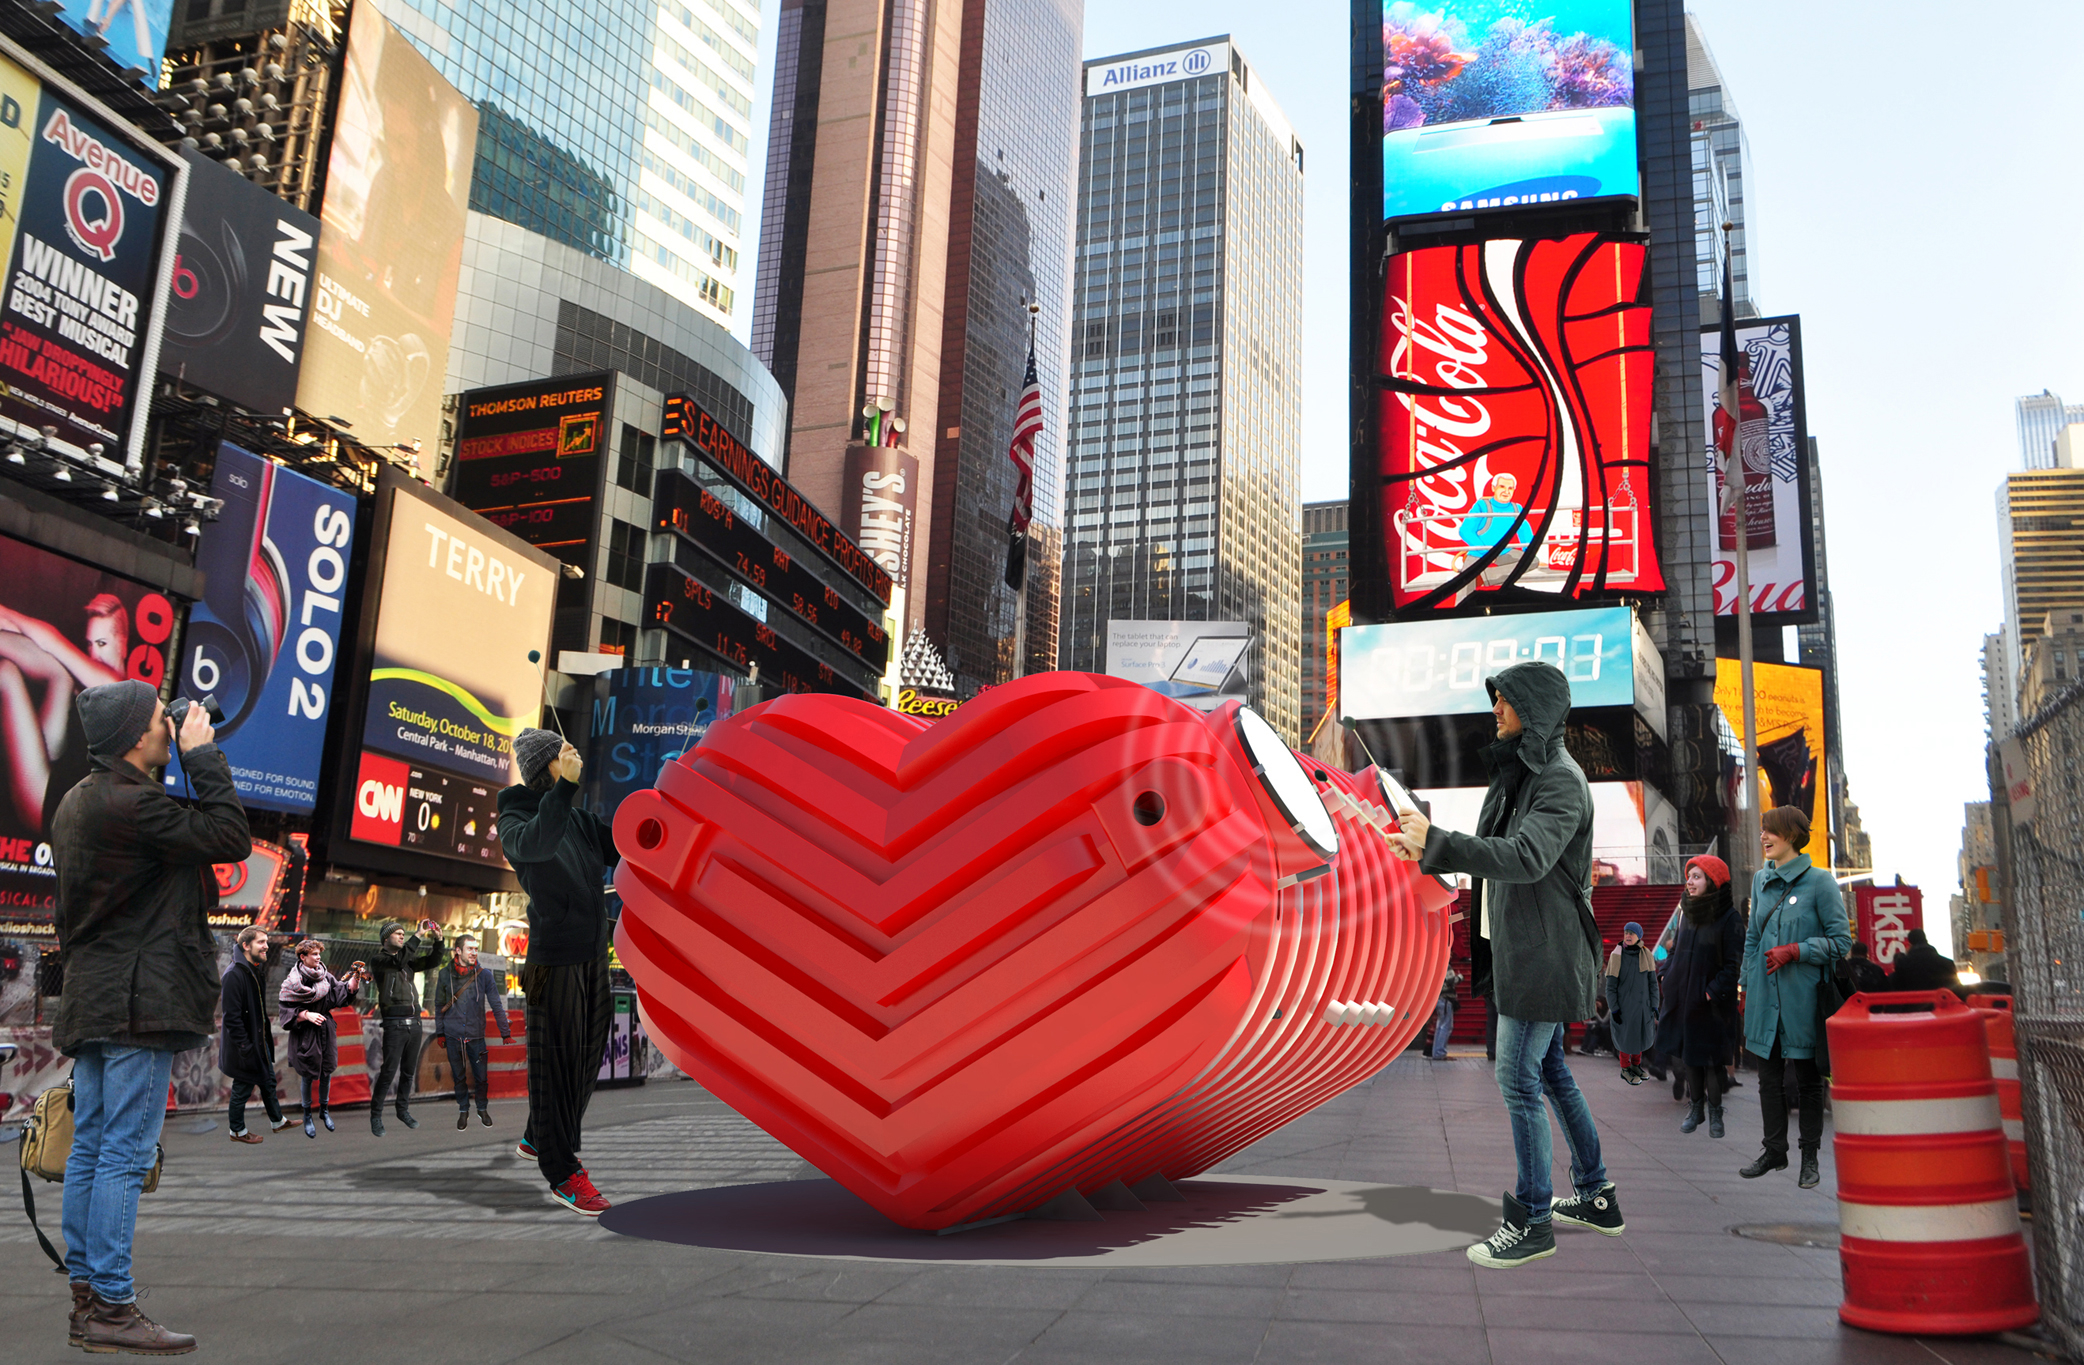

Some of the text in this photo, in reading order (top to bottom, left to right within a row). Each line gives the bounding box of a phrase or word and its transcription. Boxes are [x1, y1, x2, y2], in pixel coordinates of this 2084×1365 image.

[1103, 61, 1177, 86] Allianz
[43, 108, 159, 206] Avenue
[64, 167, 124, 262] Q
[22, 232, 139, 331] WINNER
[260, 219, 313, 364] NEW
[319, 273, 371, 318] ULTIMATE
[14, 271, 136, 348] 2004 TONY AWARD
[315, 288, 342, 321] DJ
[9, 288, 129, 369] BEST MUSICAL
[313, 312, 365, 353] HEADBAND
[42, 339, 124, 392] DROPPINGLY
[470, 387, 602, 417] THOMSON REUTERS
[462, 432, 554, 457] STOCK INDICES
[229, 473, 248, 489] solo
[490, 466, 561, 487] S&P-500
[698, 411, 769, 499] EARNINGS
[833, 531, 873, 590] PROFITS
[901, 509, 911, 573] CHOCOLATE
[425, 522, 525, 607] TERRY
[287, 504, 351, 720] SOLO 2
[684, 577, 712, 610] SPLS
[1112, 641, 1138, 649] replace
[898, 689, 963, 716] Reese'
[1766, 707, 1774, 715] to
[1768, 694, 1799, 703] peanuts
[388, 701, 514, 755] Saturday, October 18, 201
[397, 726, 510, 770] Central Park Manhattan, NY
[632, 723, 675, 737] Morgan
[229, 766, 263, 780] SIGNED
[265, 772, 284, 784] FOR
[254, 784, 272, 795] FOR
[409, 787, 443, 804] NEW YORK
[359, 780, 404, 823] CNN
[207, 911, 252, 926] oshack
[1873, 892, 1913, 964] tkts
